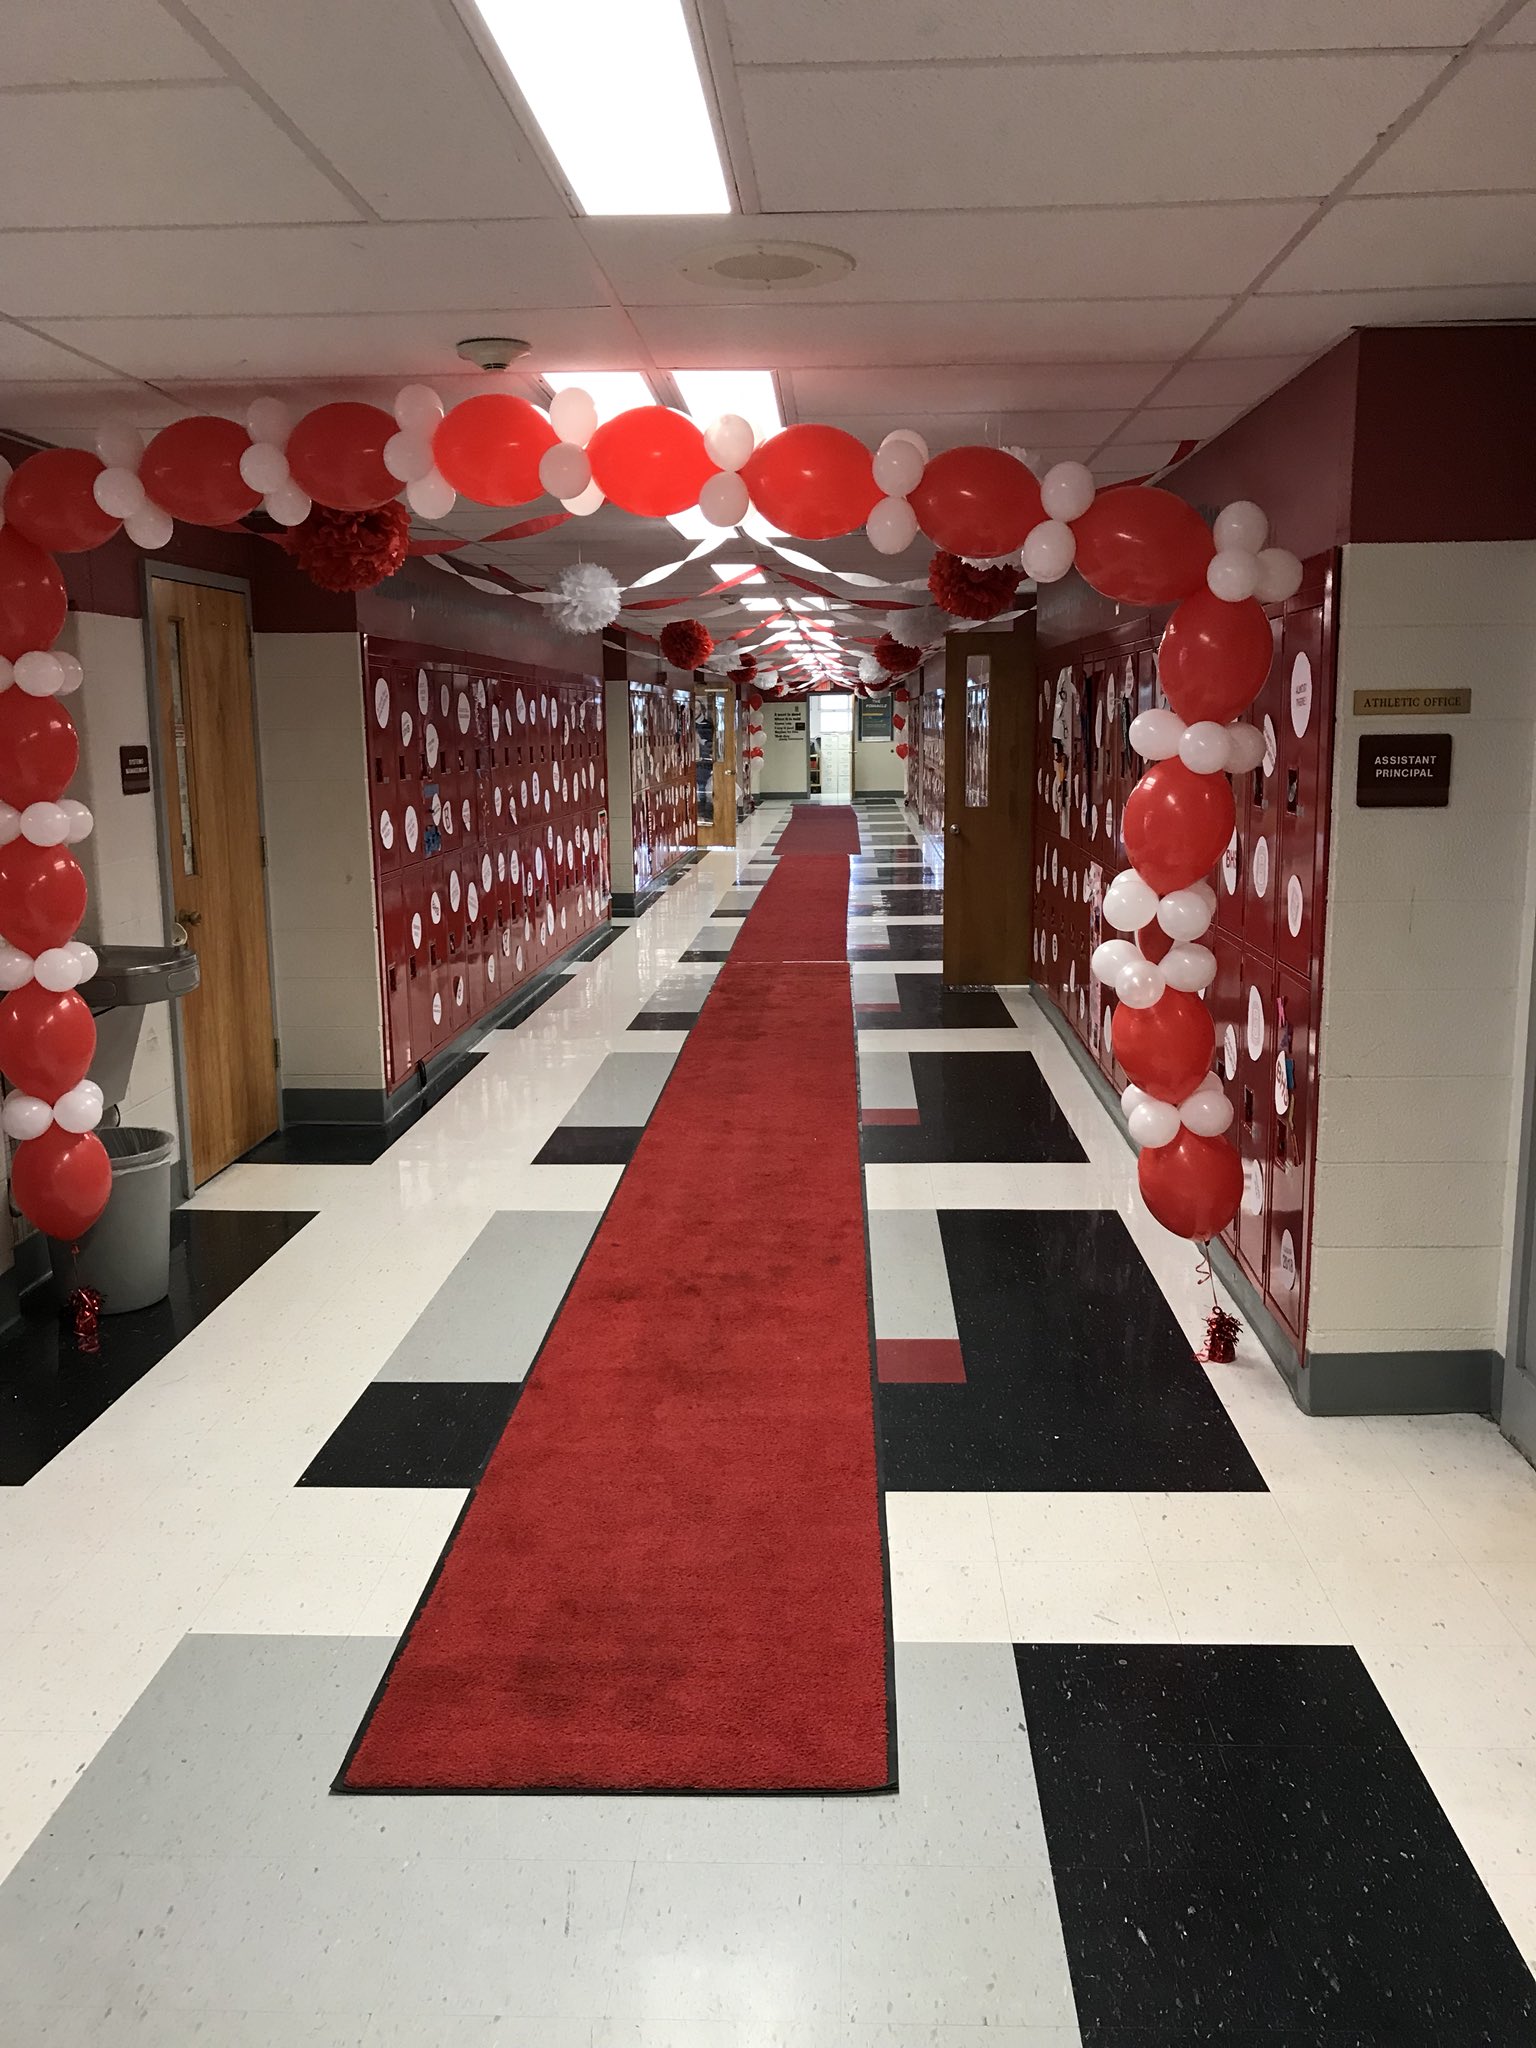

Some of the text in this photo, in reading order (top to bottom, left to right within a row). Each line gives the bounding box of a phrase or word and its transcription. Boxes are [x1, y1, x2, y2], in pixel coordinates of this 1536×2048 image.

[1363, 696, 1462, 708] ATHLETIC OFFICE
[1374, 755, 1437, 765] ASSISTANT
[1375, 768, 1433, 778] PRINCIPAL
